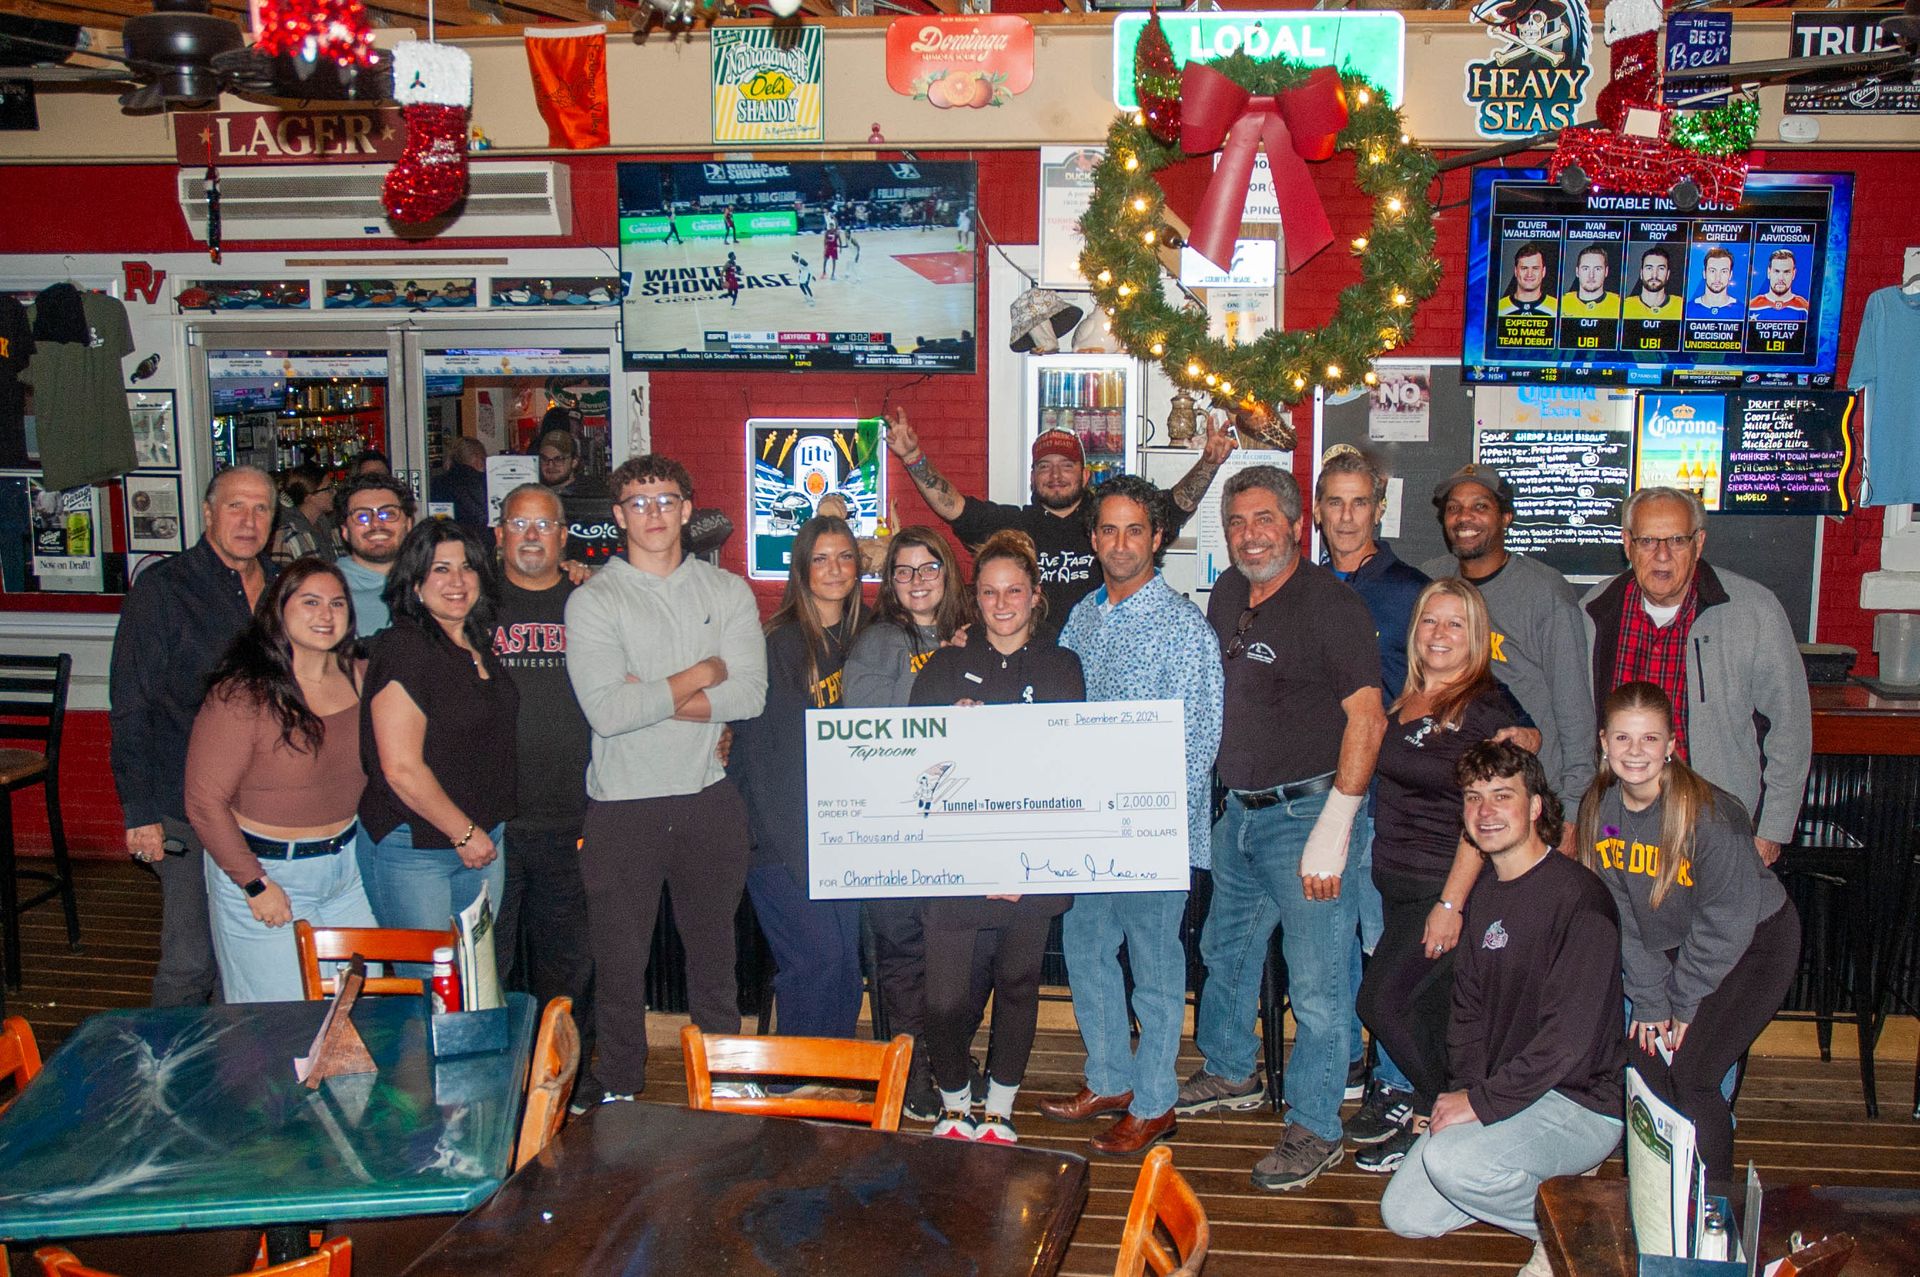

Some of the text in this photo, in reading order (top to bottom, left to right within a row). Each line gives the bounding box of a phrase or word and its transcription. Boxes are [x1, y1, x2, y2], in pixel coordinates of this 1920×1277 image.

[1693, 20, 1708, 28] THE
[1689, 30, 1726, 45] BEST
[911, 26, 1008, 62] Dominga
[1668, 42, 1728, 72] Beer
[726, 42, 809, 84] Narragansett
[1471, 68, 1585, 100] HEAVY
[737, 99, 798, 123] SHANDY
[1484, 102, 1570, 131] SEAS
[216, 116, 377, 157] LAGER
[727, 166, 790, 180] SHOWCASE
[1587, 196, 1650, 210] NOTABLE
[1517, 221, 1547, 229] OLIVER
[1585, 222, 1606, 230] IVAN
[1641, 223, 1677, 232] NICOLAS
[1701, 224, 1744, 233] ANTHONY
[1770, 225, 1802, 234] VIKTOR
[1504, 230, 1560, 239] WAHLSTROM
[1569, 231, 1621, 240] BARBASHEV
[1649, 232, 1668, 240] ROY
[1706, 233, 1738, 242] CIRELLI
[1760, 234, 1810, 243] ARVIDSSON
[1505, 319, 1548, 327] EXPECTED
[1580, 319, 1598, 327] OUT
[1643, 321, 1661, 329] OUT
[1690, 322, 1739, 331] GAME-TIME
[1755, 322, 1799, 331] EXPECTED
[1507, 328, 1546, 337] TO MAKE
[1694, 331, 1734, 340] DECISION
[1759, 331, 1795, 340] TO PLAY
[1499, 337, 1553, 346] TEAM DEBUT
[1577, 337, 1598, 348] UBI
[1640, 338, 1661, 349] UBI
[1684, 340, 1741, 350] UNDISCLOSED
[1765, 340, 1785, 352] LBI
[889, 357, 912, 365] PACKERS
[1812, 375, 1831, 384] LIVE
[1379, 383, 1421, 405] NO
[1747, 400, 1781, 409] DRAFT
[1540, 403, 1581, 417] Extra
[1744, 412, 1771, 421] Coors
[1648, 413, 1718, 439] Corona
[1742, 421, 1772, 431] Miller
[1575, 433, 1608, 442] BISQUE
[1742, 430, 1804, 442] Narragansett
[1741, 439, 1810, 450] Michelob Ultra
[801, 446, 832, 466] Lite
[1787, 452, 1808, 461] DOWN
[1728, 473, 1777, 483] CINDERLANDS
[1727, 482, 1831, 492] SIERRA NEVADA Celebration
[41, 561, 56, 569] Now
[70, 561, 91, 570] Draft!
[1048, 711, 1159, 727] DATE December 25, 2024
[817, 717, 947, 741] DUCK INN
[848, 744, 917, 761] Taproom
[818, 800, 866, 808] PAY TO THE
[943, 797, 1082, 812] Tunnel Towers Foundation
[1108, 795, 1170, 809] $ 2,000.00
[818, 810, 862, 819] ORDER OF
[821, 829, 924, 844] Two Thousand and
[1136, 828, 1178, 837] DOLLARS
[1628, 842, 1693, 887] DUK
[819, 868, 965, 888] FOR Charitable Donation
